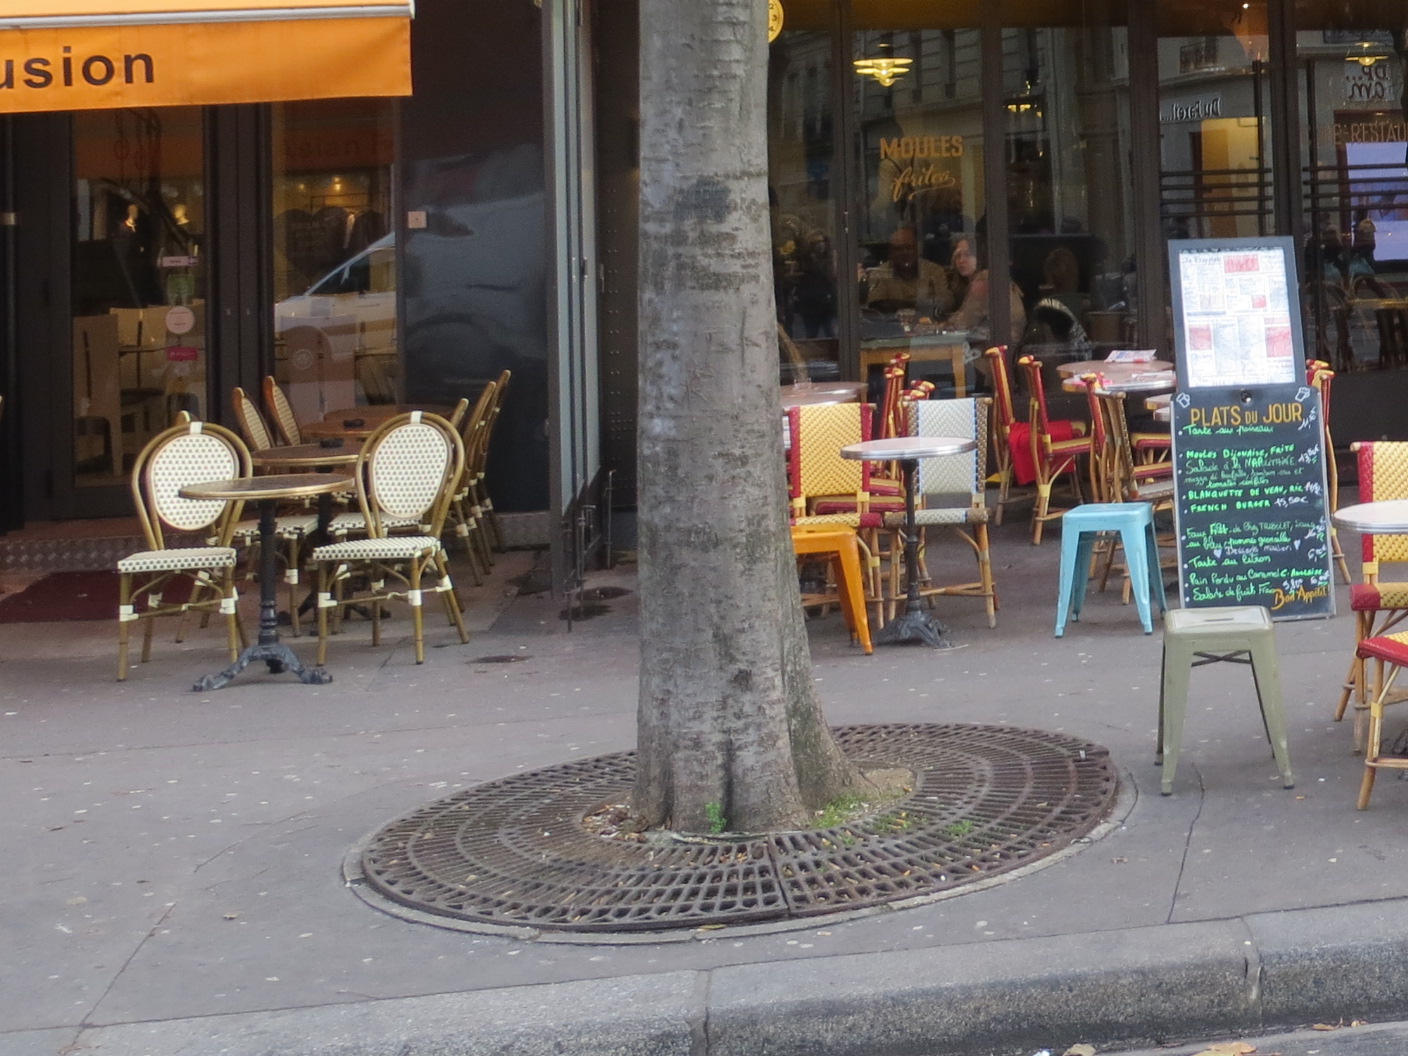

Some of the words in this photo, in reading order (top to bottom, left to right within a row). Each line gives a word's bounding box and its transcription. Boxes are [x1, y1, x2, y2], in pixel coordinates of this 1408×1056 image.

[880, 135, 964, 159] MOULES
[891, 164, 956, 202] frites
[1190, 405, 1241, 426] PLATS
[1245, 410, 1258, 424] DU
[1262, 402, 1303, 424] JOUR
[1188, 488, 1243, 500] BLANQUETTE
[1249, 487, 1260, 496] DE
[1190, 504, 1227, 513] FRENCH
[1235, 499, 1271, 510] BURGER
